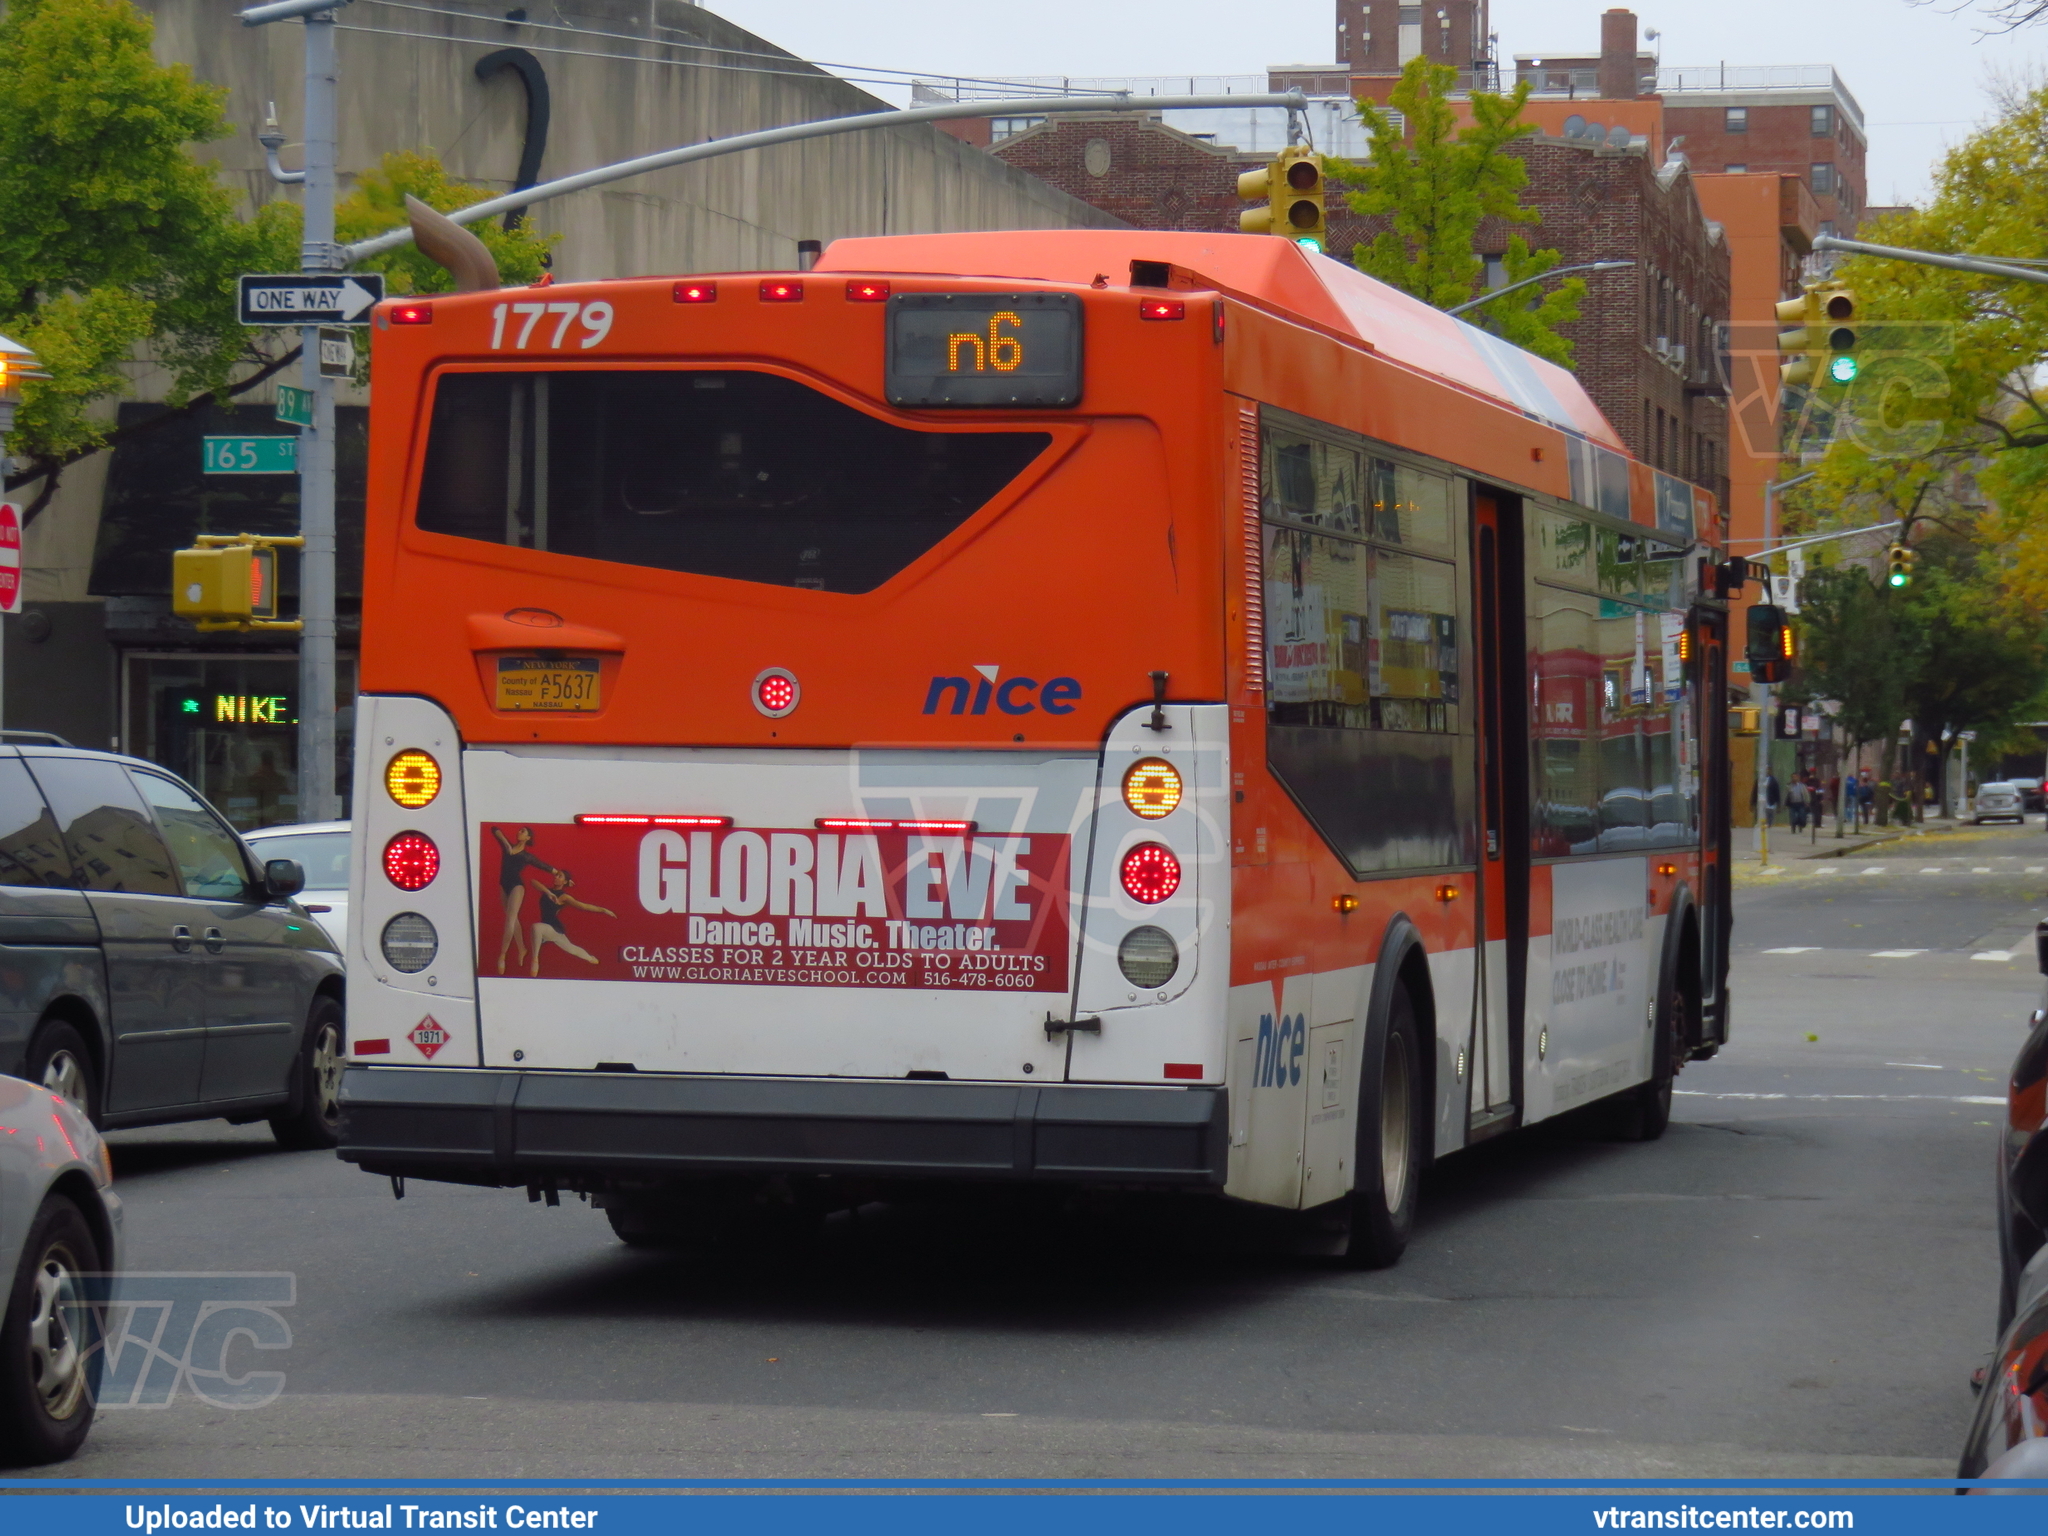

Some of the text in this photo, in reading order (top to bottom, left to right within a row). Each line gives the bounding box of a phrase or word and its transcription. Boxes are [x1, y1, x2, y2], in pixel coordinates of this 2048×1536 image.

[256, 290, 341, 310] ONE WAY
[491, 301, 614, 350] 1779
[949, 311, 1022, 371] n6
[277, 388, 295, 417] 89
[206, 441, 295, 469] 165 ST
[523, 660, 576, 670] NEW YORK
[501, 676, 538, 687] County of
[505, 687, 533, 697] Nassau
[540, 674, 551, 686] A
[552, 673, 595, 700] 5637
[922, 664, 1082, 716] nice
[638, 829, 1031, 921] GLORIA EVE
[688, 916, 1001, 951] Dance. Music. Theater.
[622, 946, 1046, 971] CLASSES FOR 2 YEAR OLDS TO ADULTS
[632, 965, 1036, 988] WWW.GLORIAEVESCHOOL.COM 516-478-6060
[418, 1030, 440, 1043] 1971
[425, 1047, 432, 1055] 2
[1252, 1012, 1305, 1089] nice
